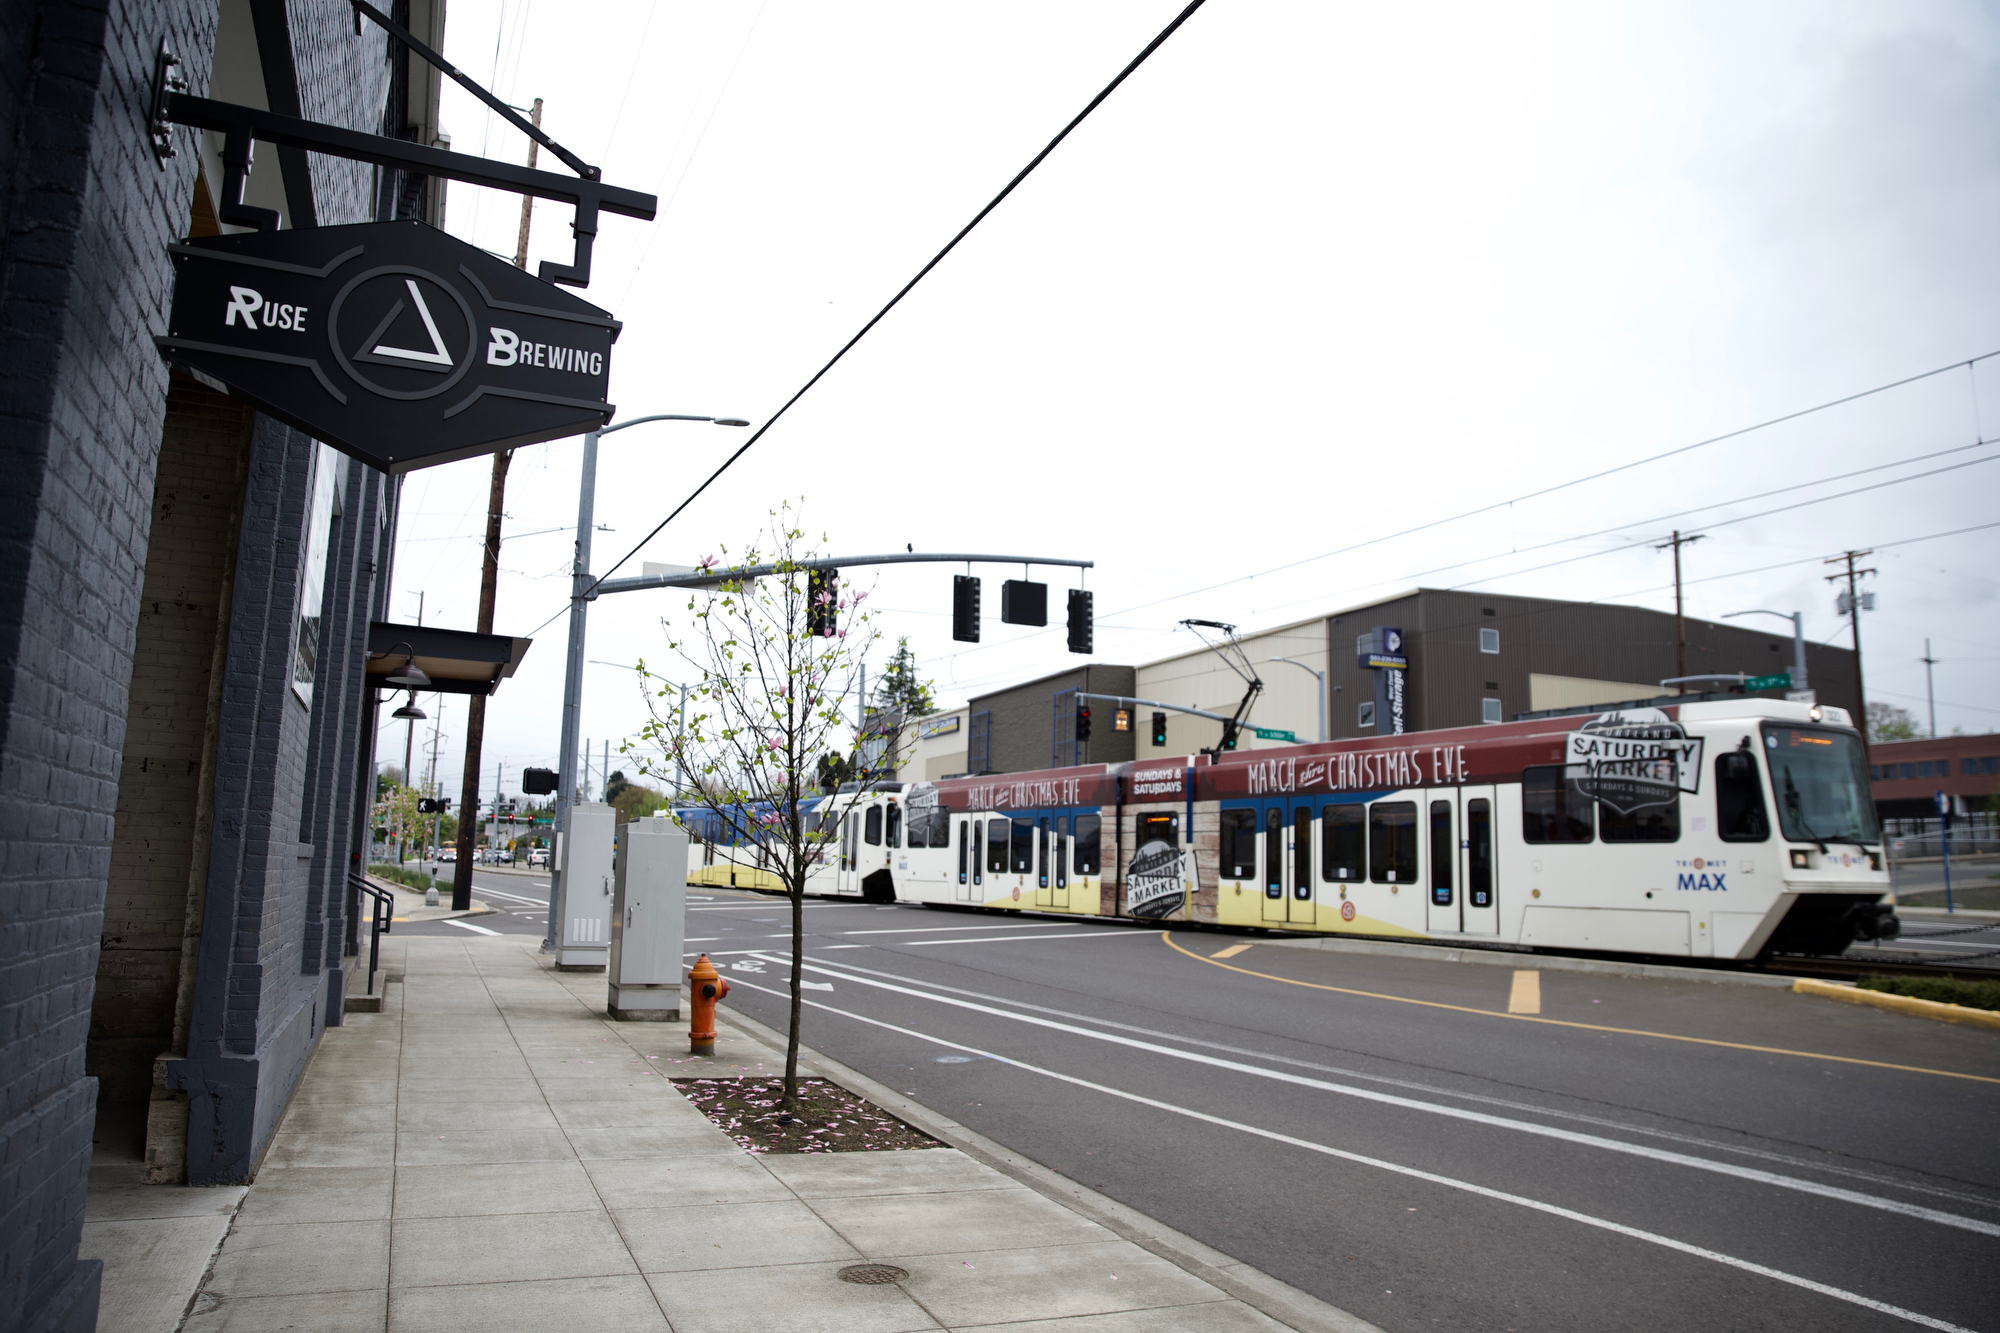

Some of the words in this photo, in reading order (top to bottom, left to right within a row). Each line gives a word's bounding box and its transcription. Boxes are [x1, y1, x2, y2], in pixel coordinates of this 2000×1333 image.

[225, 285, 308, 333] RUSE
[486, 327, 603, 376] BREWING
[1574, 737, 1696, 762] SATURDY
[1134, 769, 1172, 782] SUNDAYS
[1174, 768, 1182, 779] &
[1248, 758, 1296, 794] MARCH
[1301, 761, 1325, 783] thru
[1328, 750, 1422, 790] CHRISTMAS
[1433, 745, 1466, 783] EVE
[1586, 758, 1677, 782] MARKET
[968, 785, 994, 809] MARCH
[1010, 781, 1059, 808] CHRISTMAS
[1063, 779, 1080, 805] EVE
[1134, 781, 1182, 794] SATURDAYS
[1636, 785, 1670, 798] SUNDAYS
[1135, 876, 1182, 904] MARKET
[1678, 873, 1727, 891] MAX
